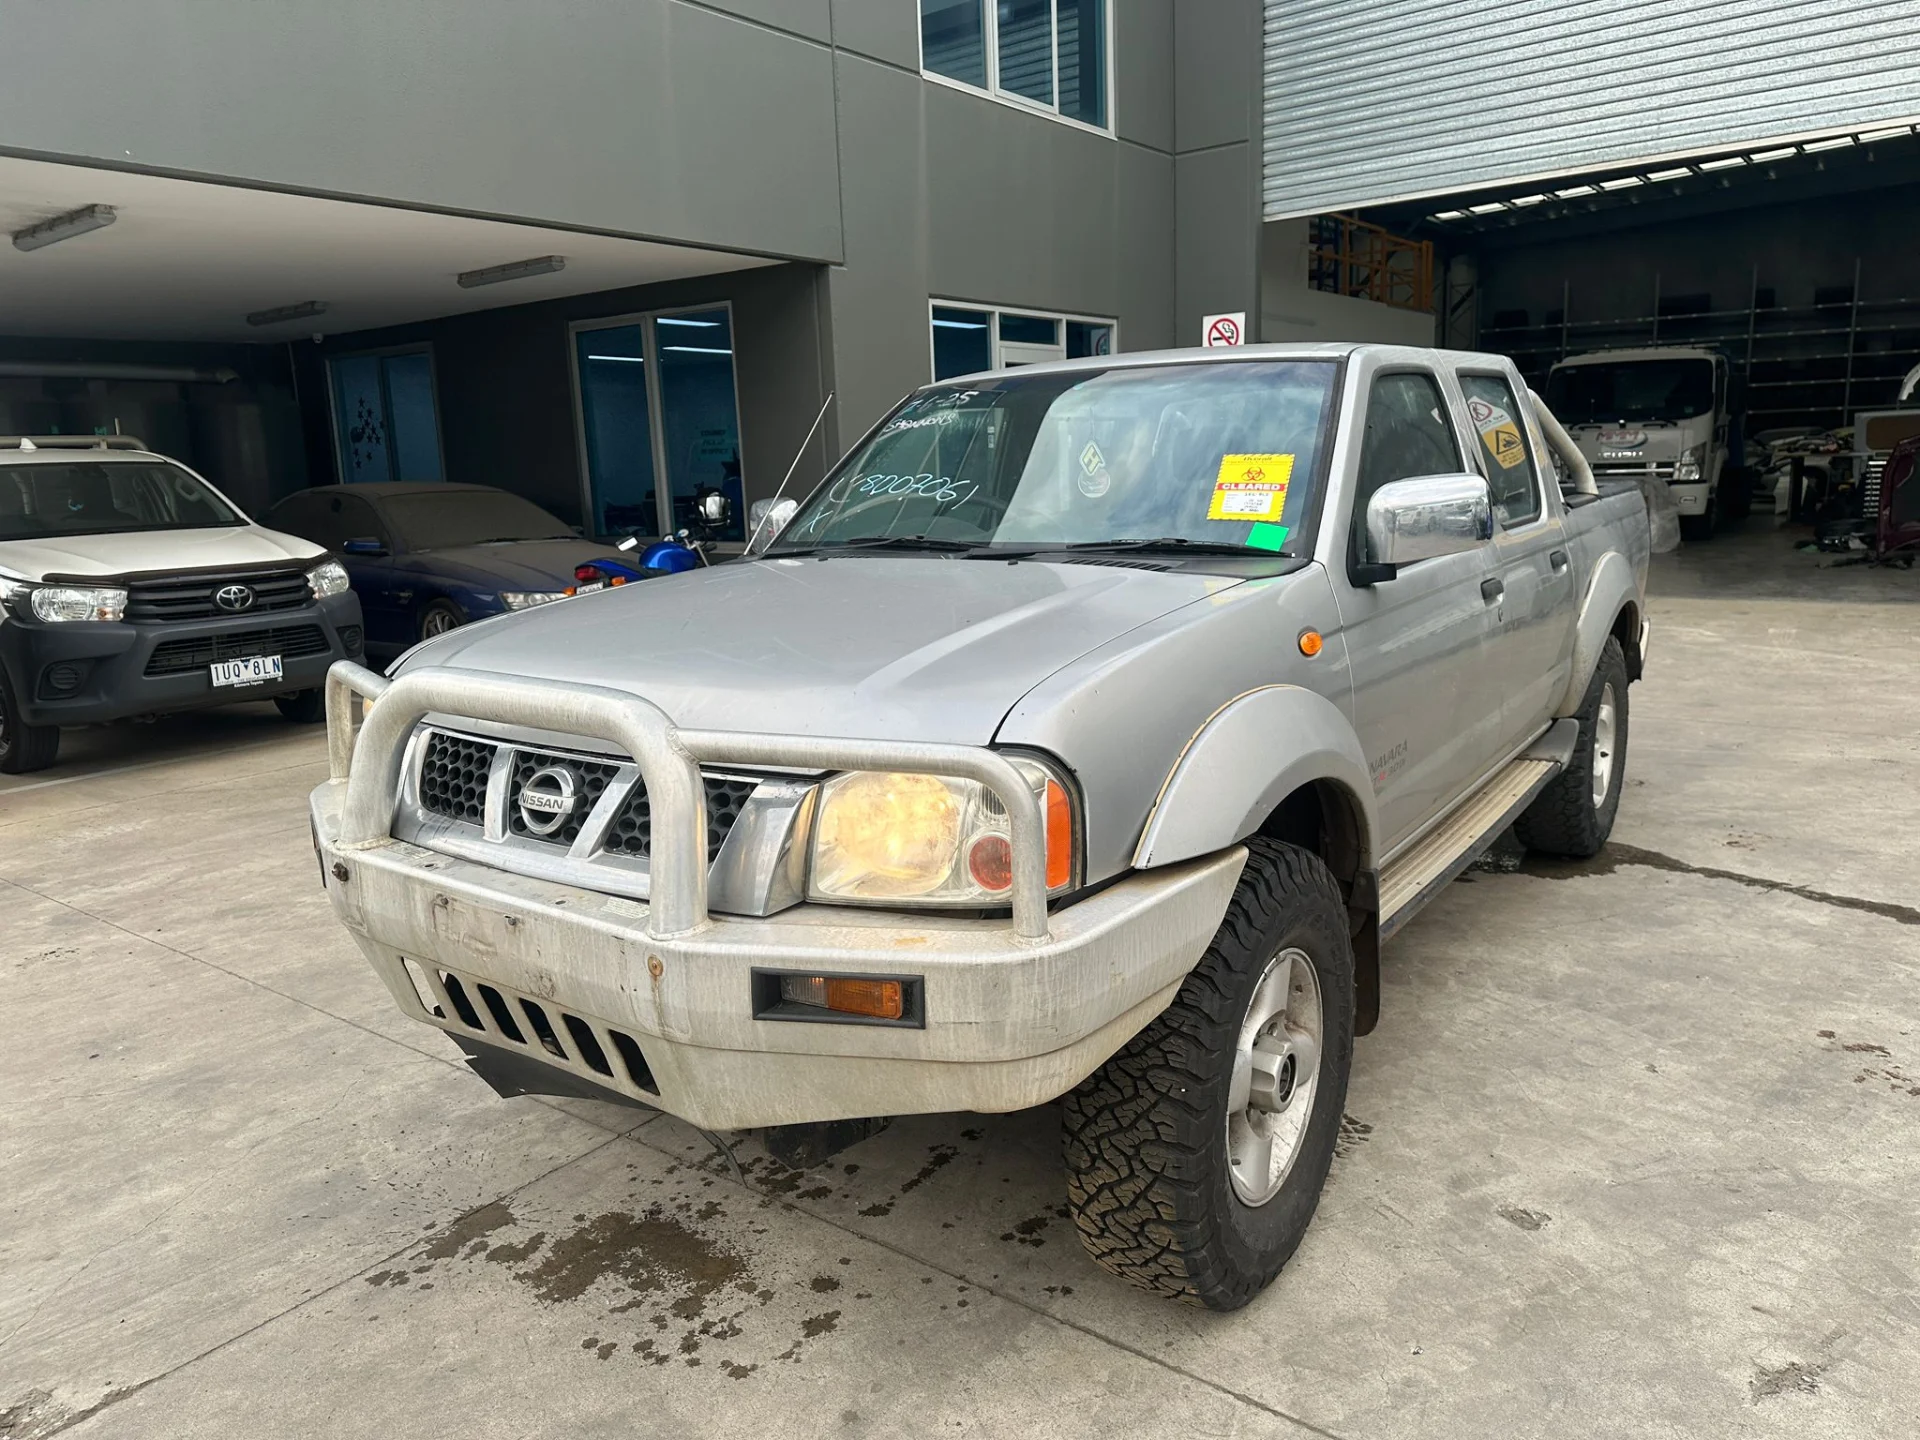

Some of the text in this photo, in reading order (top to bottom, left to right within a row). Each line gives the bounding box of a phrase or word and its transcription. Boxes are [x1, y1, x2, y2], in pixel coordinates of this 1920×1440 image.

[1221, 483, 1281, 491] CLEARED
[214, 657, 281, 681] 1UQ 8LN
[519, 793, 564, 810] NISSAN
